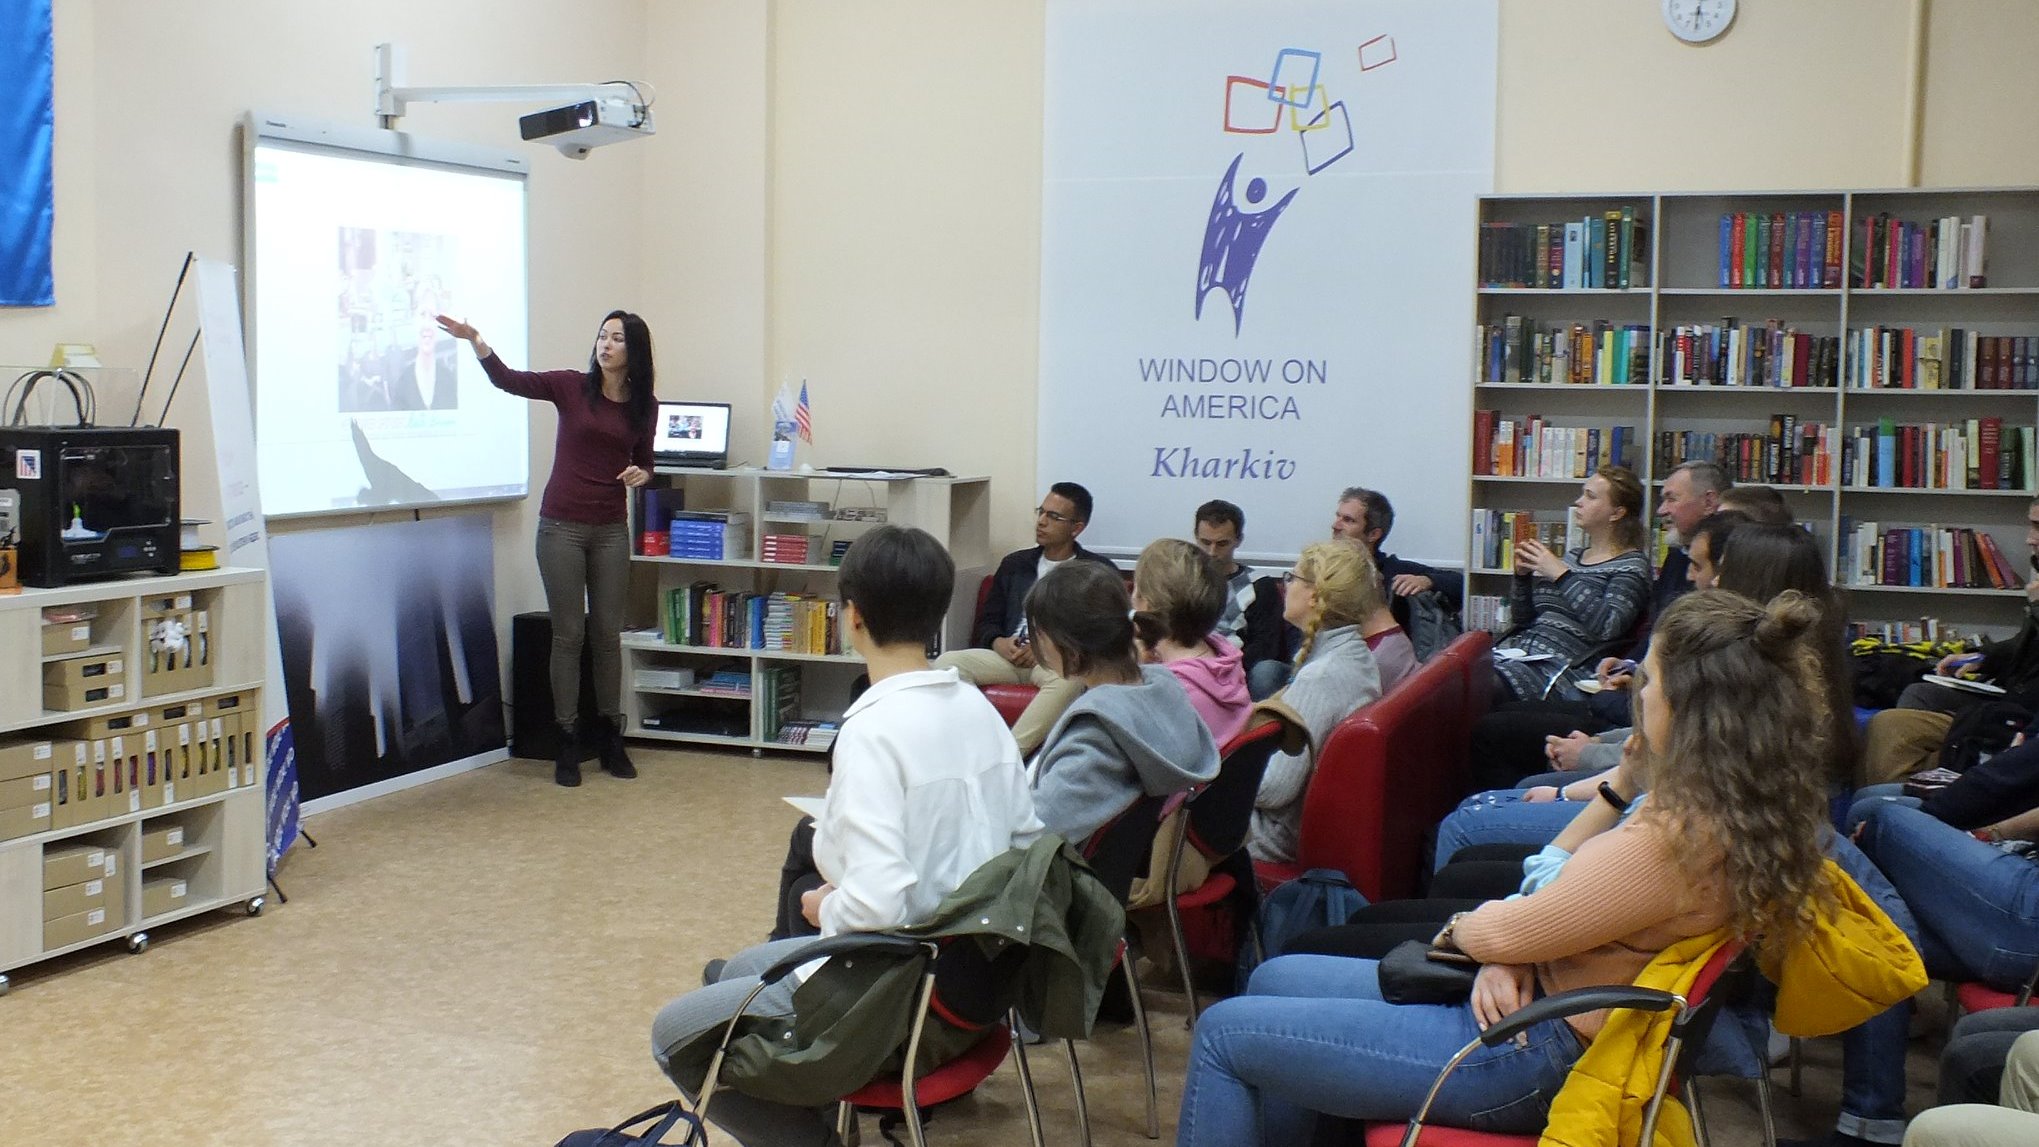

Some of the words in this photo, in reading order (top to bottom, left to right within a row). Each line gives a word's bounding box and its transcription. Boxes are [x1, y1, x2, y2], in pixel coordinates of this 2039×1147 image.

[1139, 358, 1273, 384] WINDOW
[1282, 359, 1327, 384] ON
[1160, 394, 1301, 420] AMERICA
[1150, 447, 1296, 480] Kharkiv
